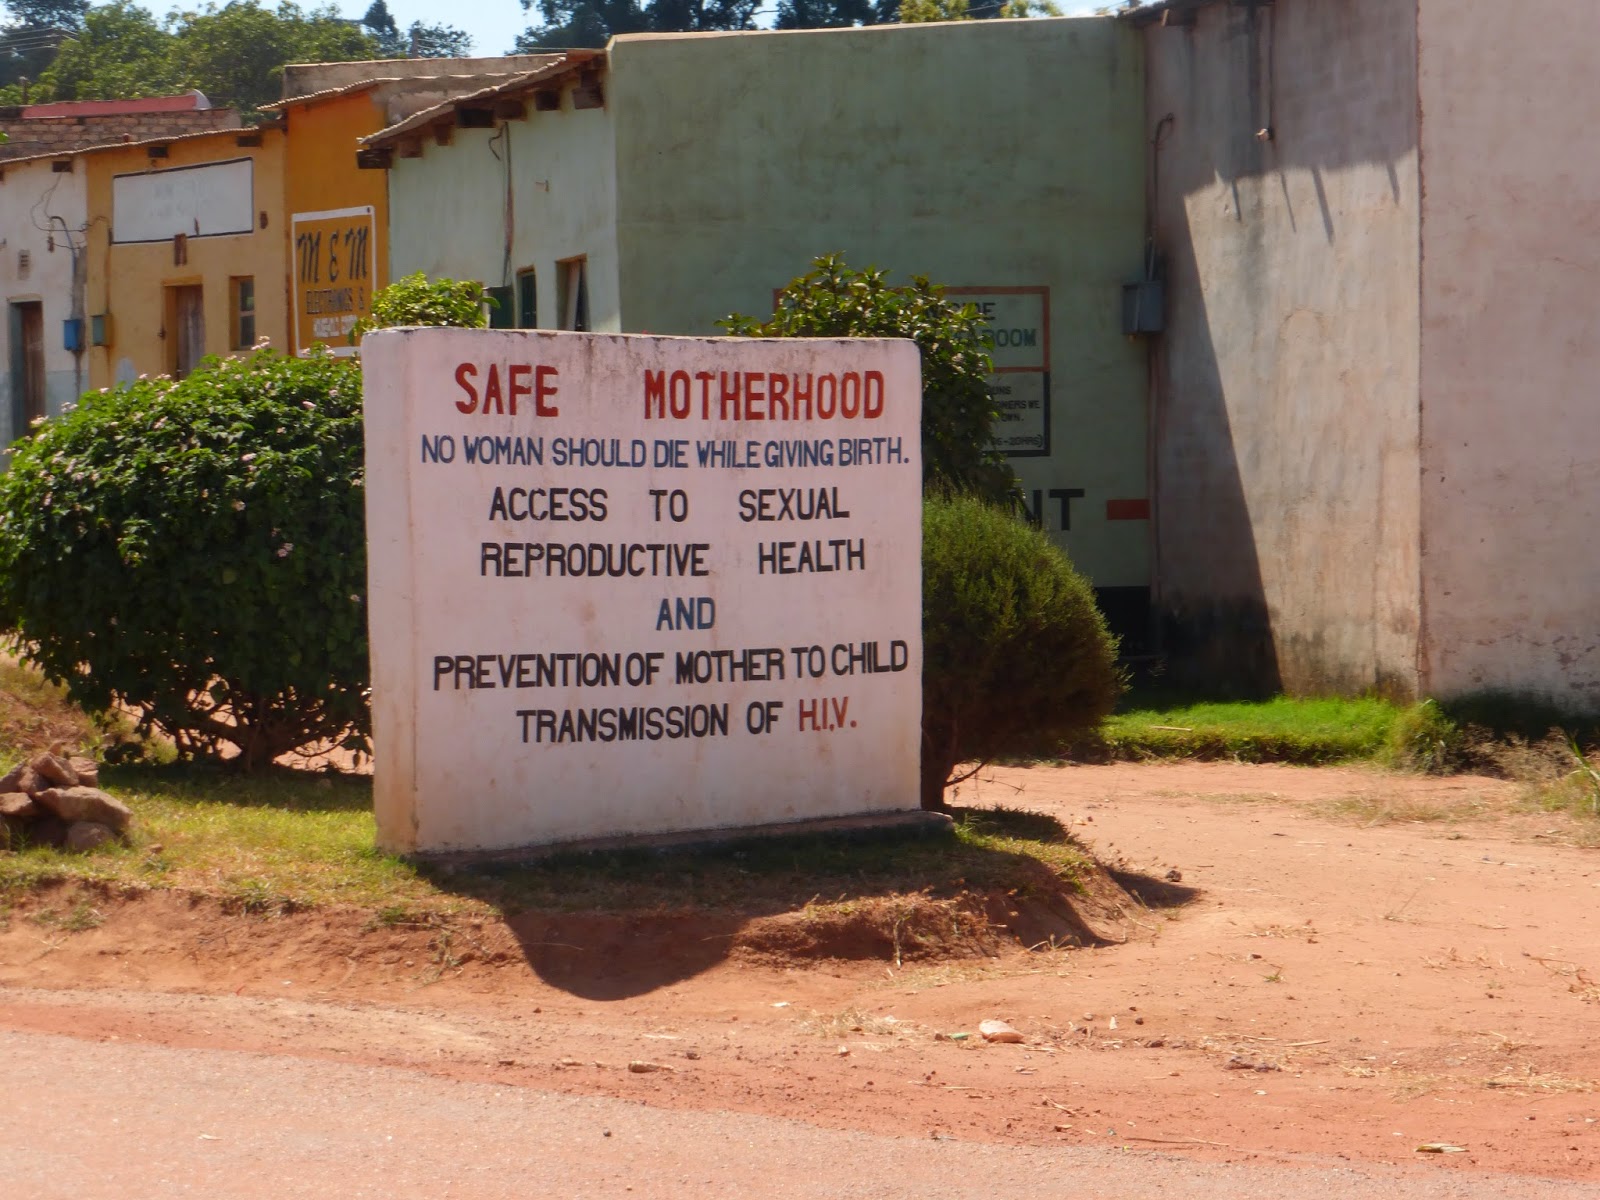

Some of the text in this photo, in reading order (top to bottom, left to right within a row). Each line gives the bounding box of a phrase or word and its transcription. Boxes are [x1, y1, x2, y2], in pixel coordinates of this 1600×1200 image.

[455, 363, 884, 421] SAFE MOTHERHOOD
[422, 435, 910, 468] NO WOMAN SHOULD DIE WHILE GIVING BIRTH.
[489, 487, 850, 522] ACCESS TO SEXUAL
[481, 539, 865, 577] REPRODUCTIVE HEALTH
[656, 597, 715, 631] AND
[434, 640, 908, 691] PREVENTION OF MOTHER TO CHILD
[516, 696, 857, 743] TRANSMISSION OF H.I.V.
